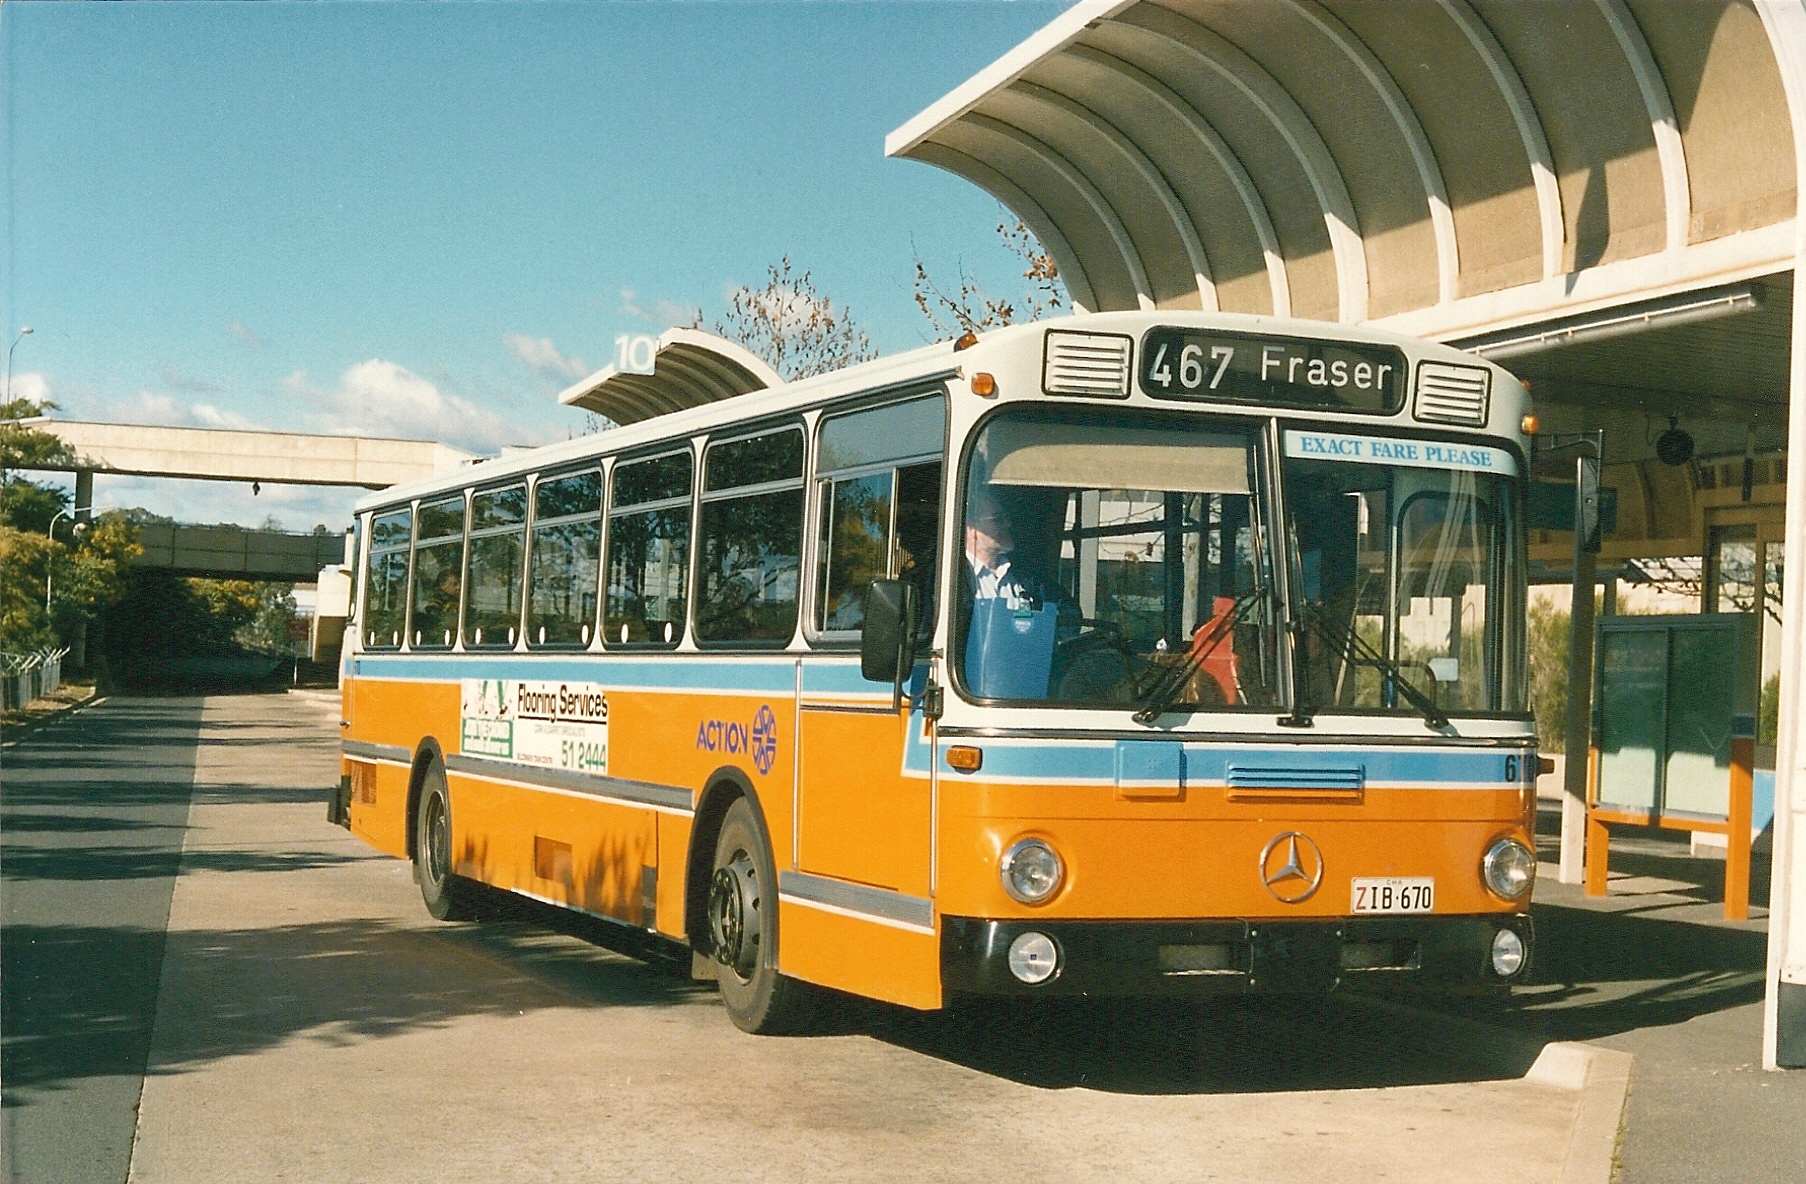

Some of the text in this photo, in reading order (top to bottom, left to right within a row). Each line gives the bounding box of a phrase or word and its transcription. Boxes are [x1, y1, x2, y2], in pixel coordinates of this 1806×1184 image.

[615, 335, 654, 371] 10
[1150, 342, 1393, 391] 467 Fraser
[1300, 436, 1493, 468] EXACT FARE PLEASE
[517, 683, 608, 723] Flooring Services
[696, 719, 749, 755] ACTION
